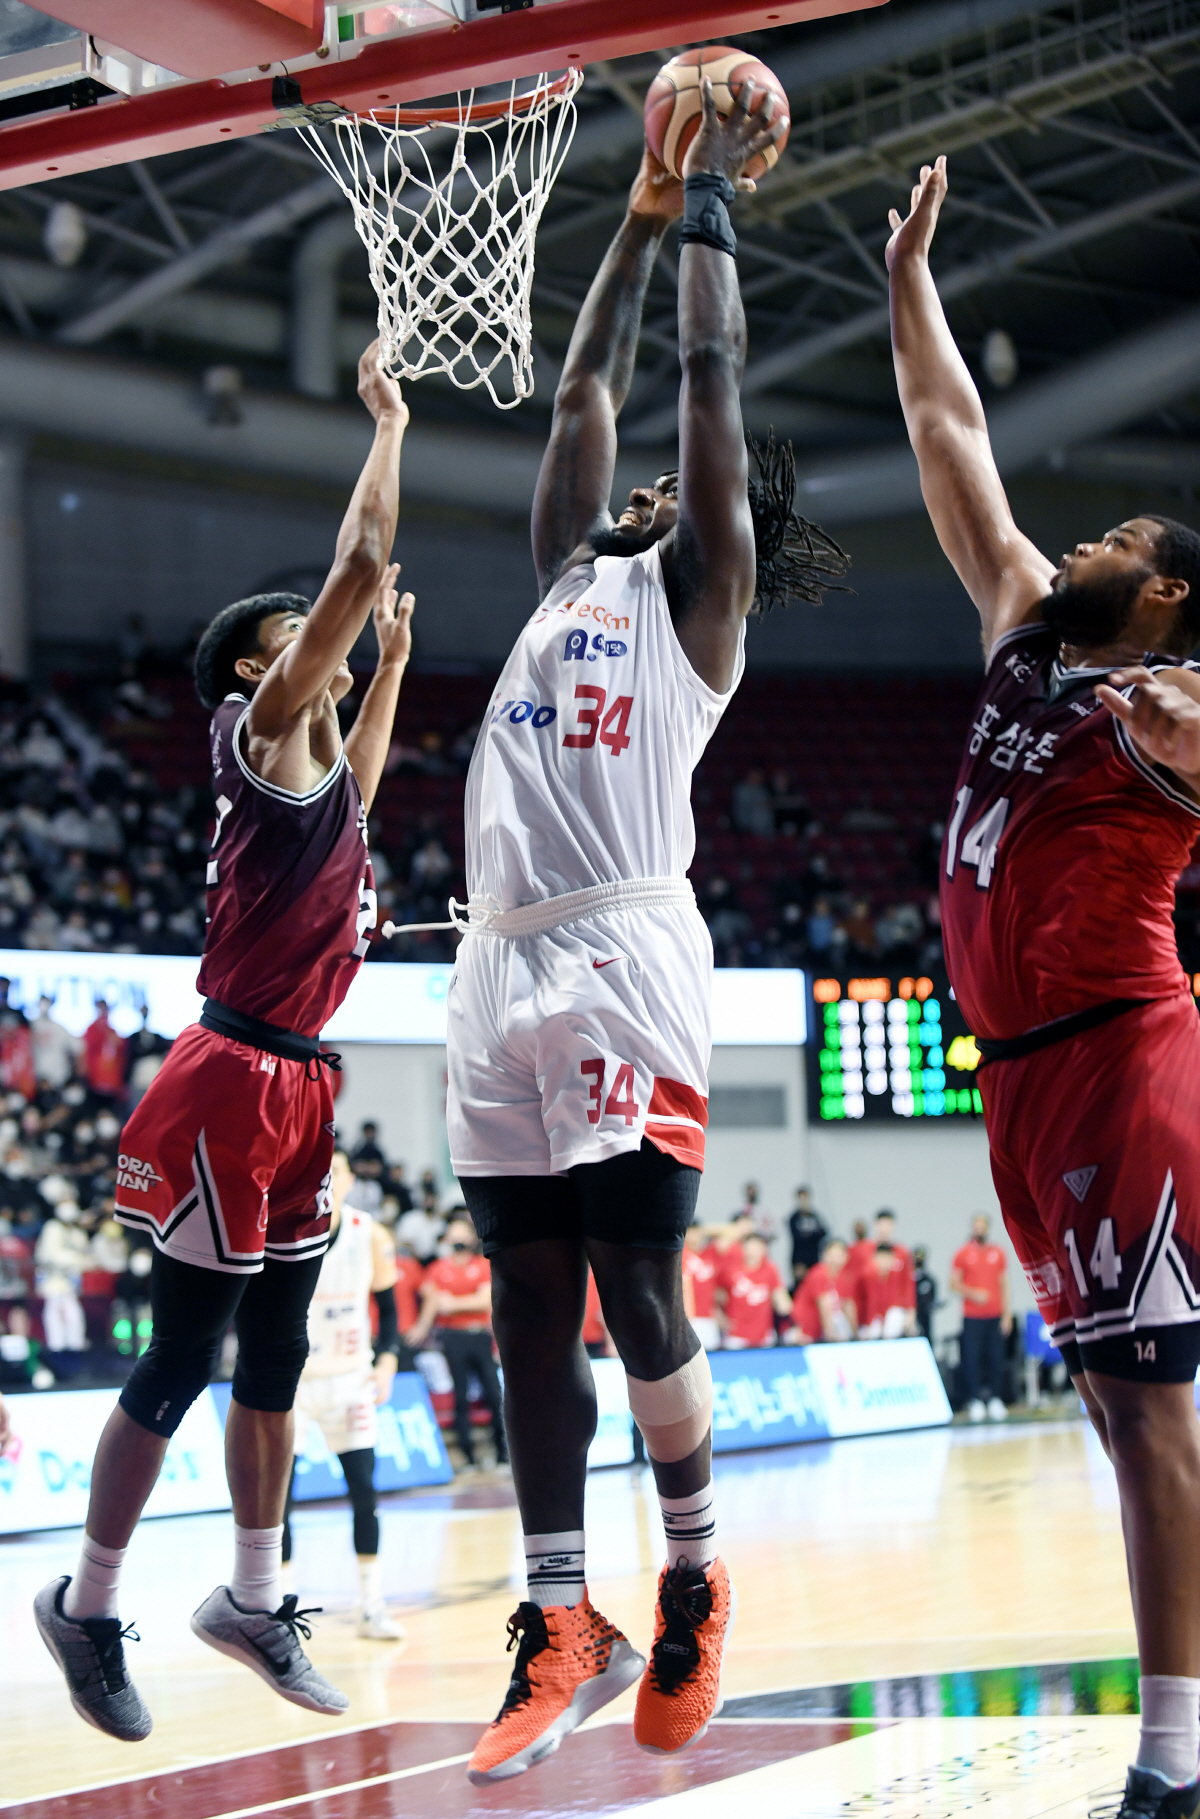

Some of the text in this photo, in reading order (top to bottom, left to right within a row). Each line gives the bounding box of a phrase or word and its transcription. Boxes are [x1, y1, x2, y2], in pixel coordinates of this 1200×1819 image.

[562, 684, 634, 757] 34
[946, 784, 1010, 887] 14
[580, 1058, 639, 1126] 34
[1063, 1217, 1122, 1298] 14
[1134, 1340, 1157, 1363] 14
